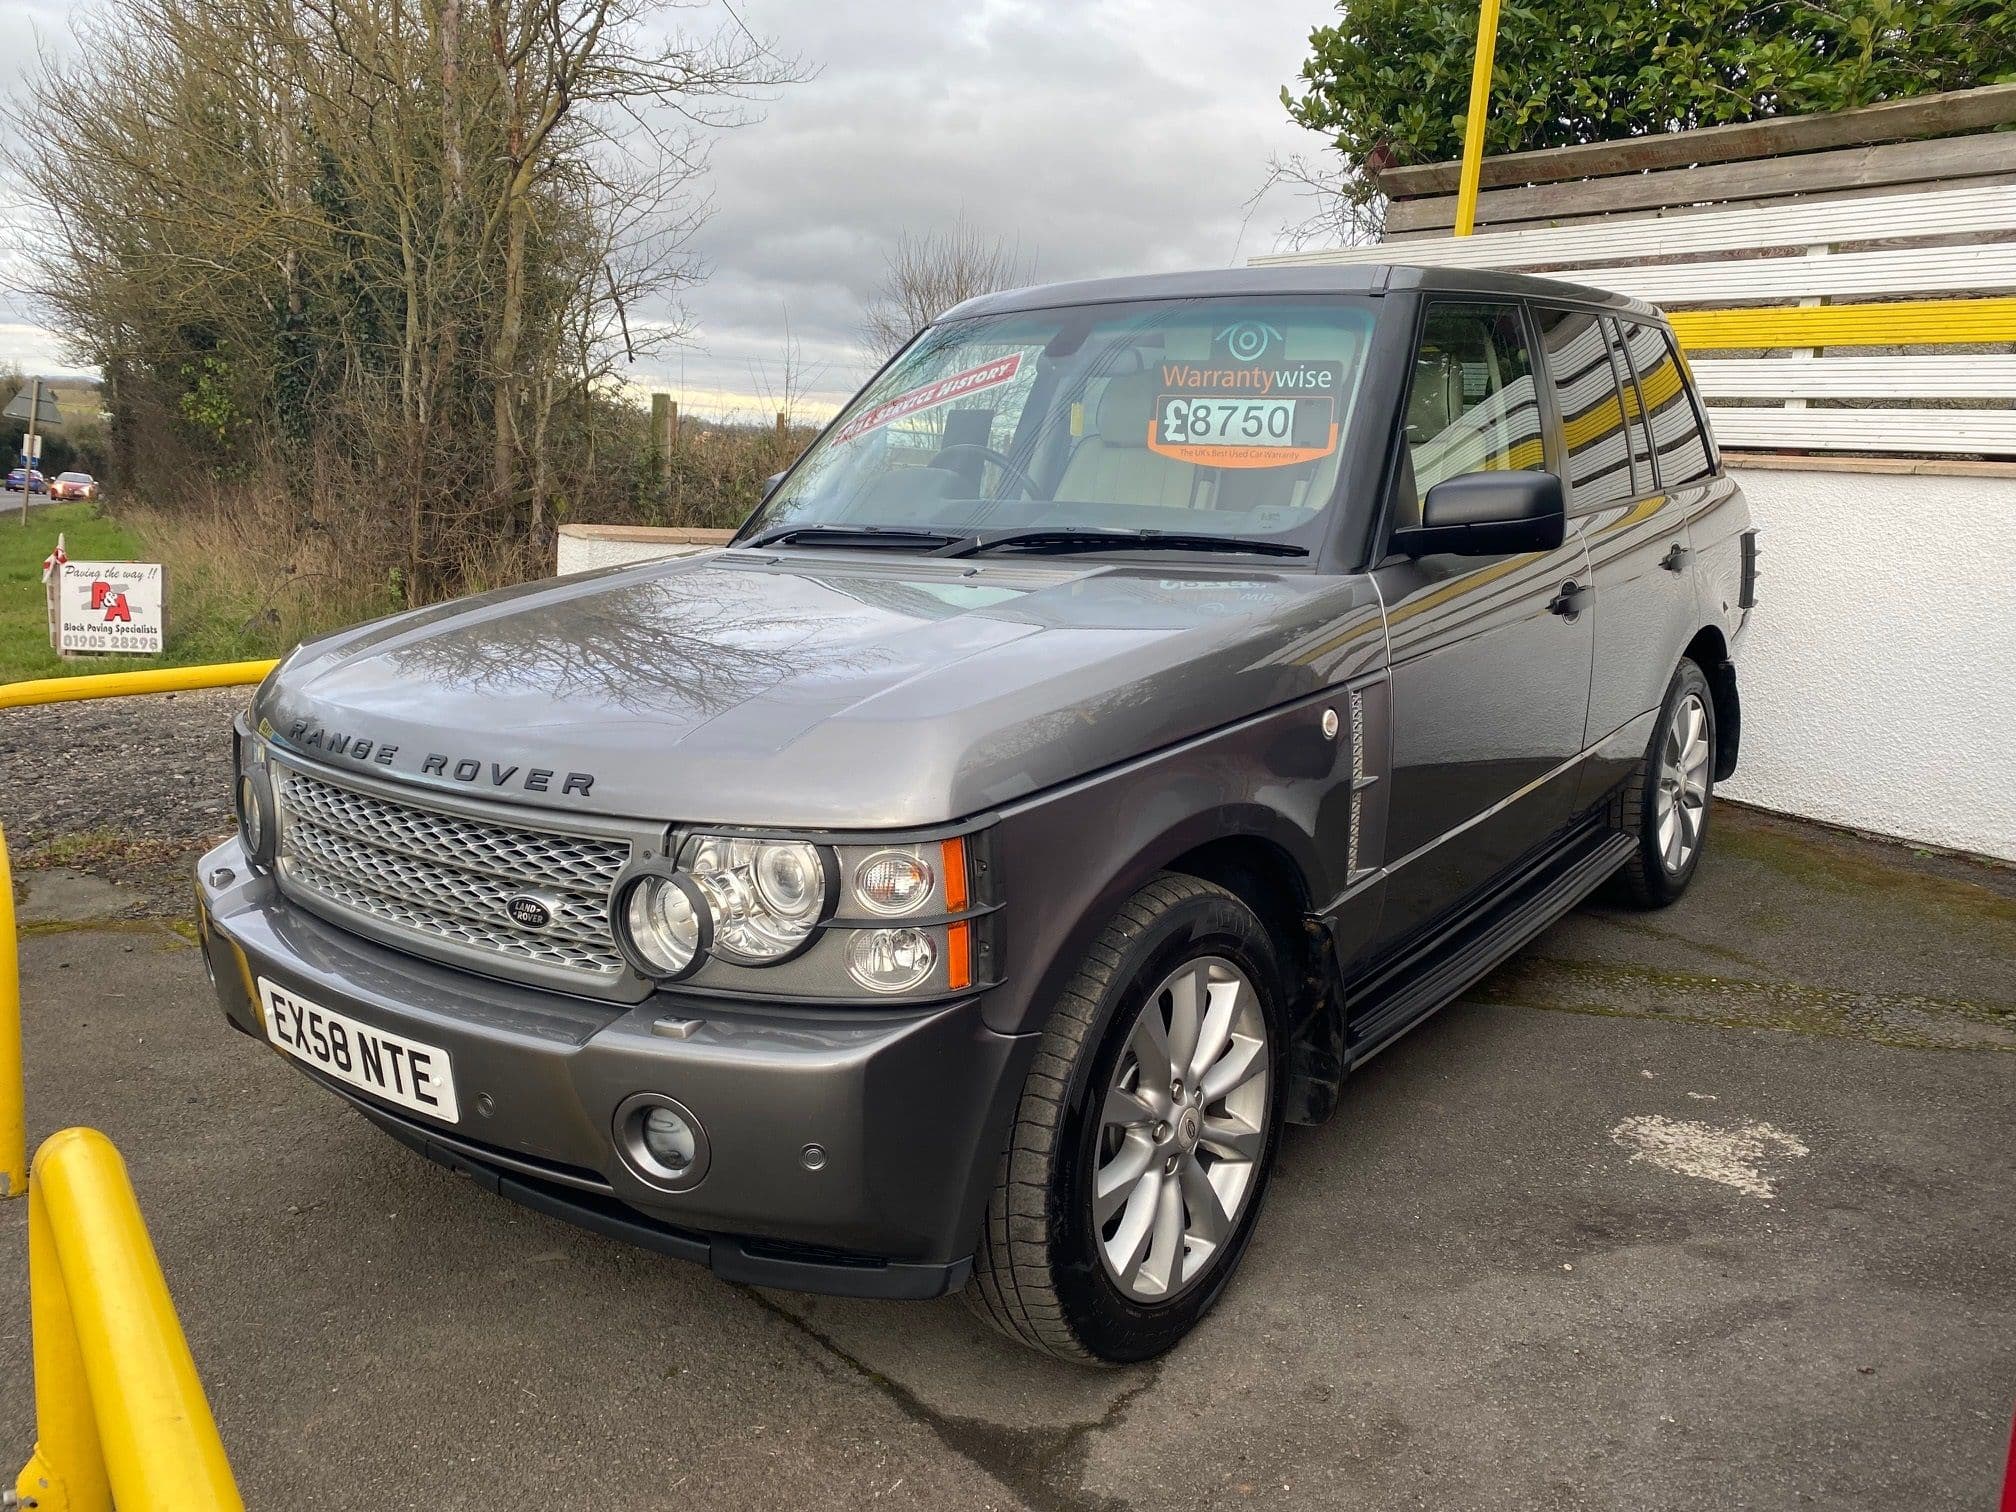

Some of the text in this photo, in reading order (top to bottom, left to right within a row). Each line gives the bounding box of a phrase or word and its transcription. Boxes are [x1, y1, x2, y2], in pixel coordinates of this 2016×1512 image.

[937, 362, 1012, 397] HISTORY
[1162, 364, 1332, 394] Warrantywise
[1164, 399, 1290, 442] £8750
[1180, 449, 1193, 457] The
[1212, 449, 1227, 457] Best
[1229, 450, 1248, 458] Used
[1249, 450, 1262, 458] Car
[1264, 451, 1299, 460] Warranty
[64, 565, 101, 581] Paving
[104, 567, 119, 578] the
[123, 571, 144, 581] way
[64, 623, 158, 635] Block Paving Specialists
[63, 635, 106, 648] 01905
[288, 719, 595, 797] RANGE ROVER
[515, 902, 537, 913] LAND
[517, 911, 543, 923] ROVER
[270, 991, 439, 1107] EX58 NTE
